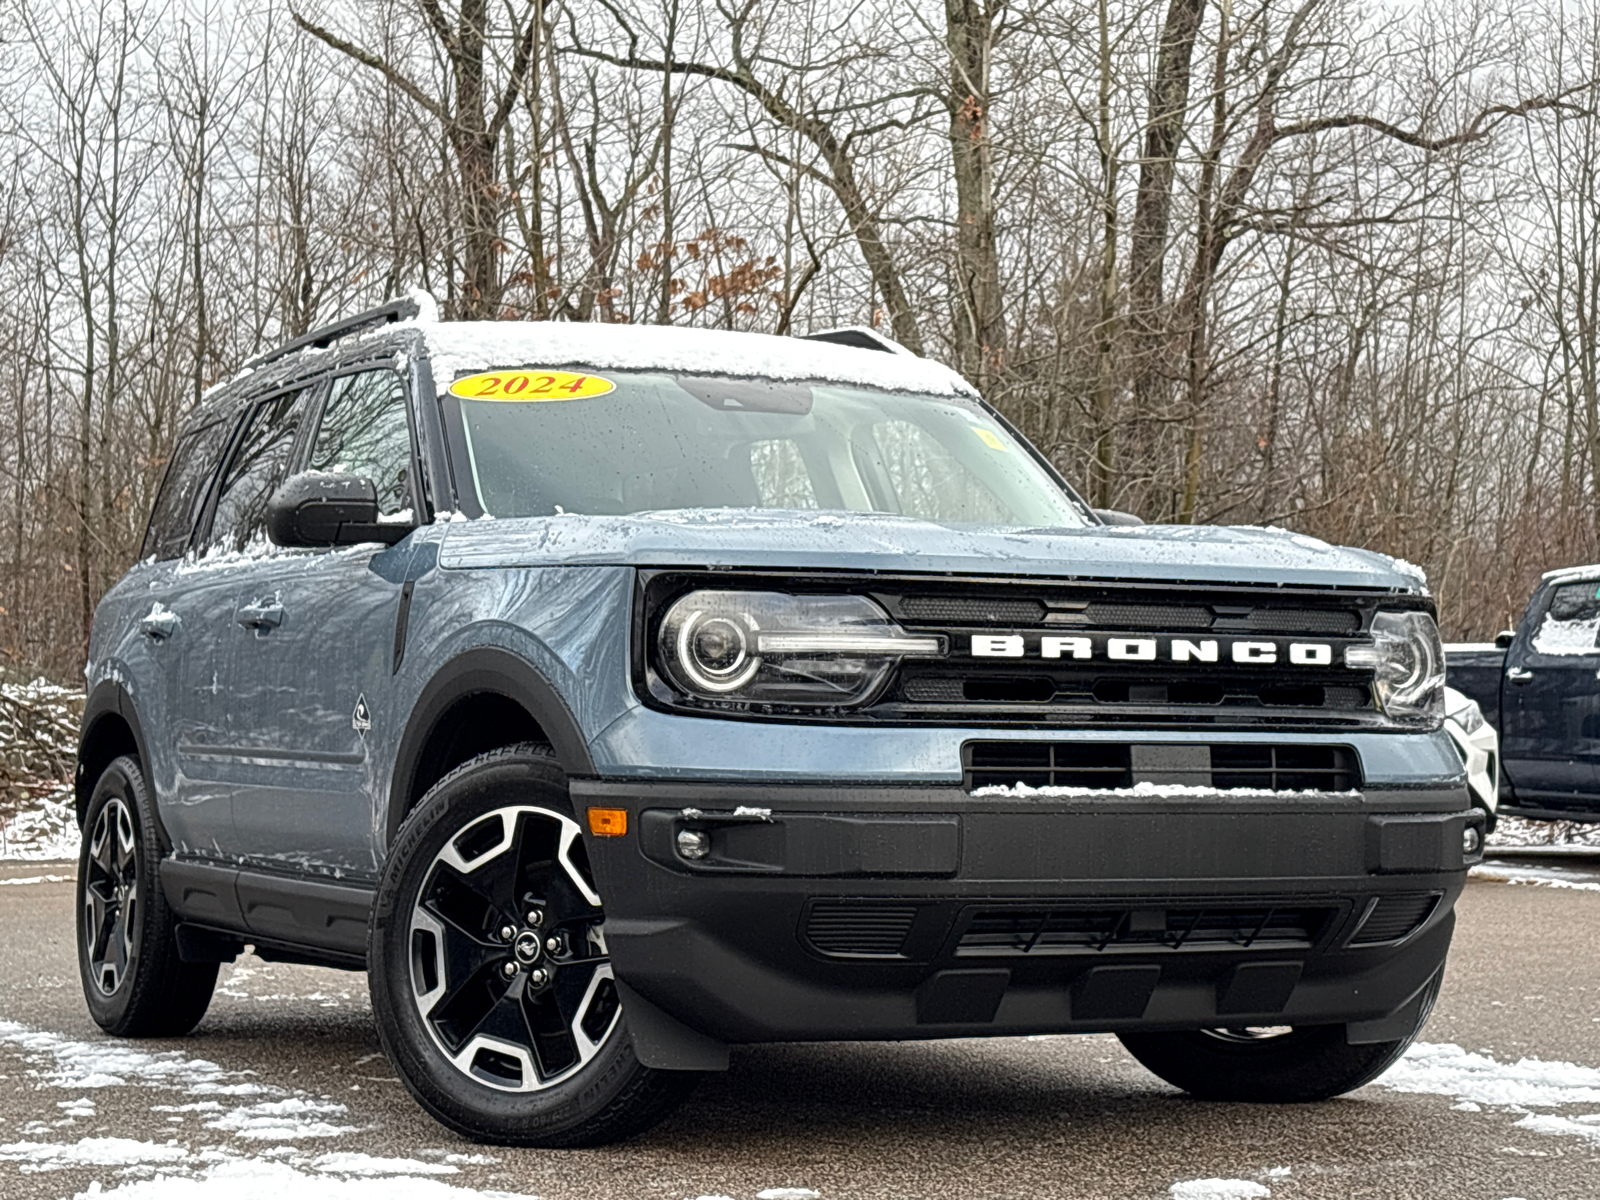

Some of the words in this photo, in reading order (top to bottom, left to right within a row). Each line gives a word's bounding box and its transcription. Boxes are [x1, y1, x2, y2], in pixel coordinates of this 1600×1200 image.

[474, 376, 587, 397] 2024
[971, 634, 1332, 665] BRONCO
[390, 801, 446, 884] MICHELIN
